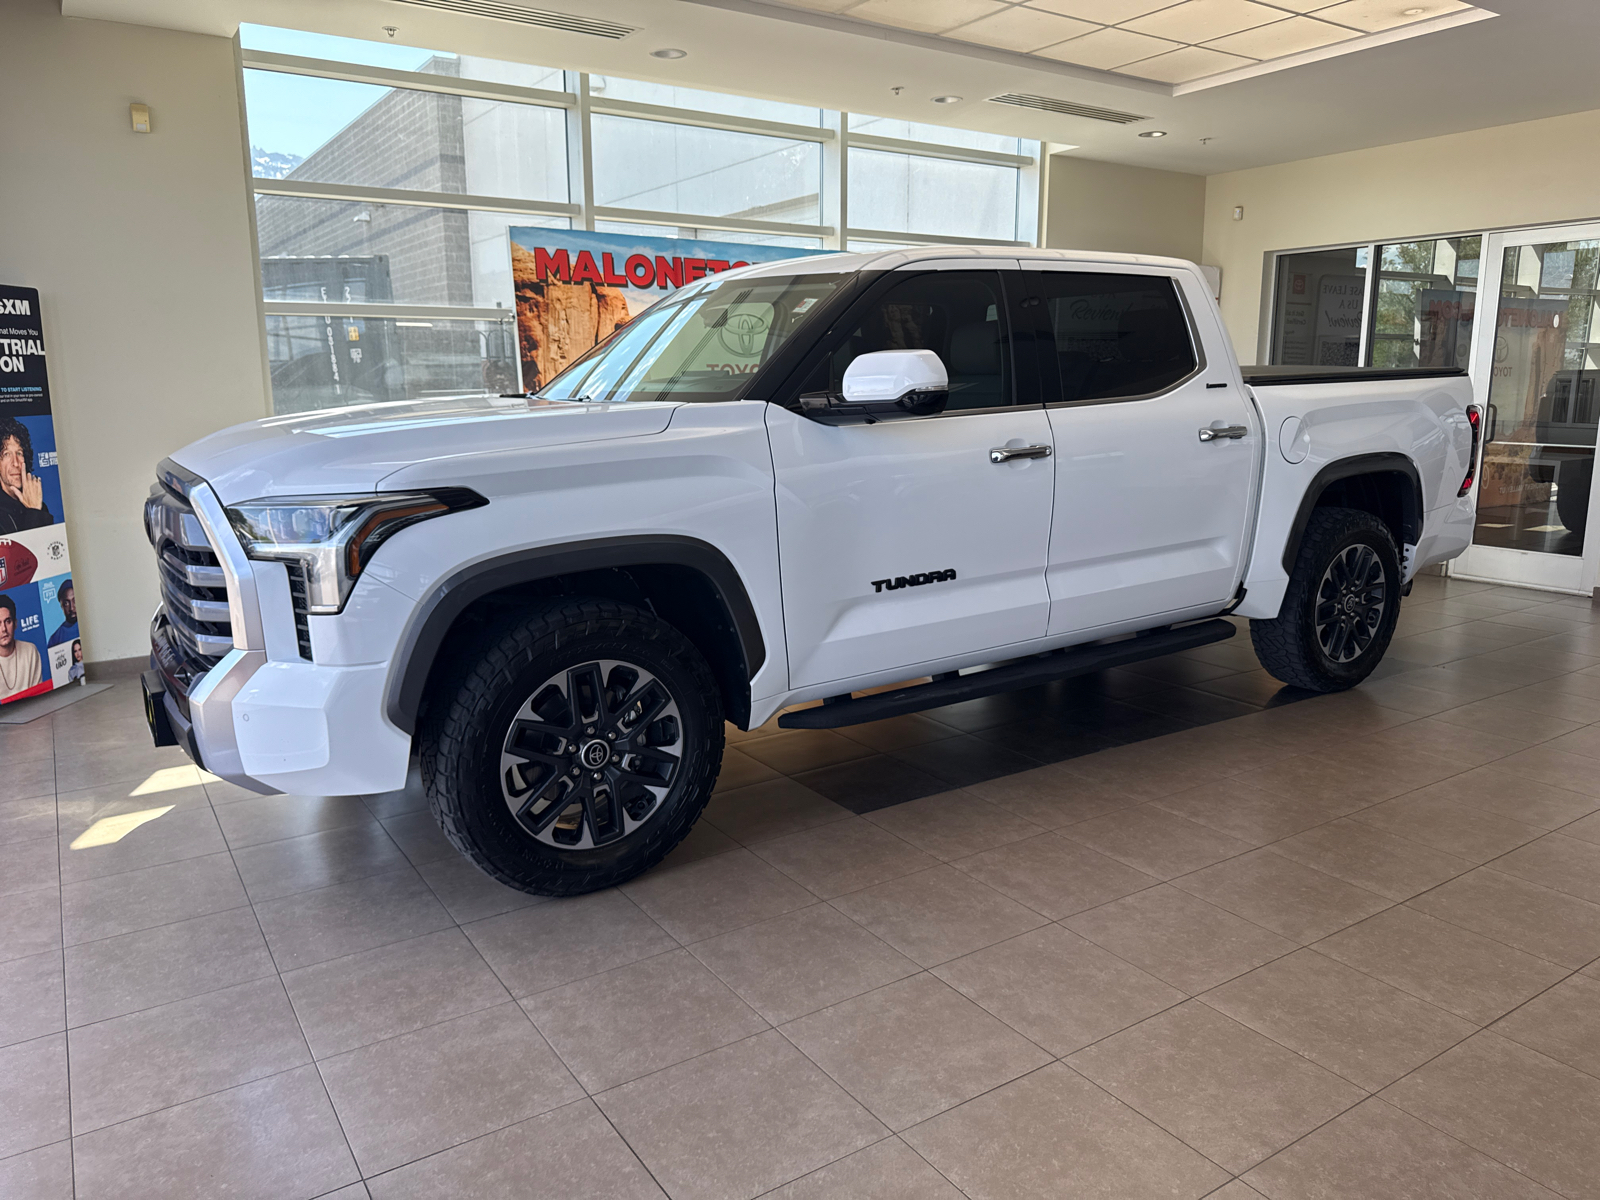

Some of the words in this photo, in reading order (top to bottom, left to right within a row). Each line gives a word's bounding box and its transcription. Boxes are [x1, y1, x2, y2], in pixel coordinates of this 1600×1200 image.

[533, 246, 753, 290] MALONET
[9, 327, 27, 336] Moves
[27, 328, 39, 336] You
[0, 338, 46, 355] TRIAL
[0, 355, 25, 373] ON
[870, 568, 957, 593] TUNDRA
[20, 614, 40, 628] LIFE
